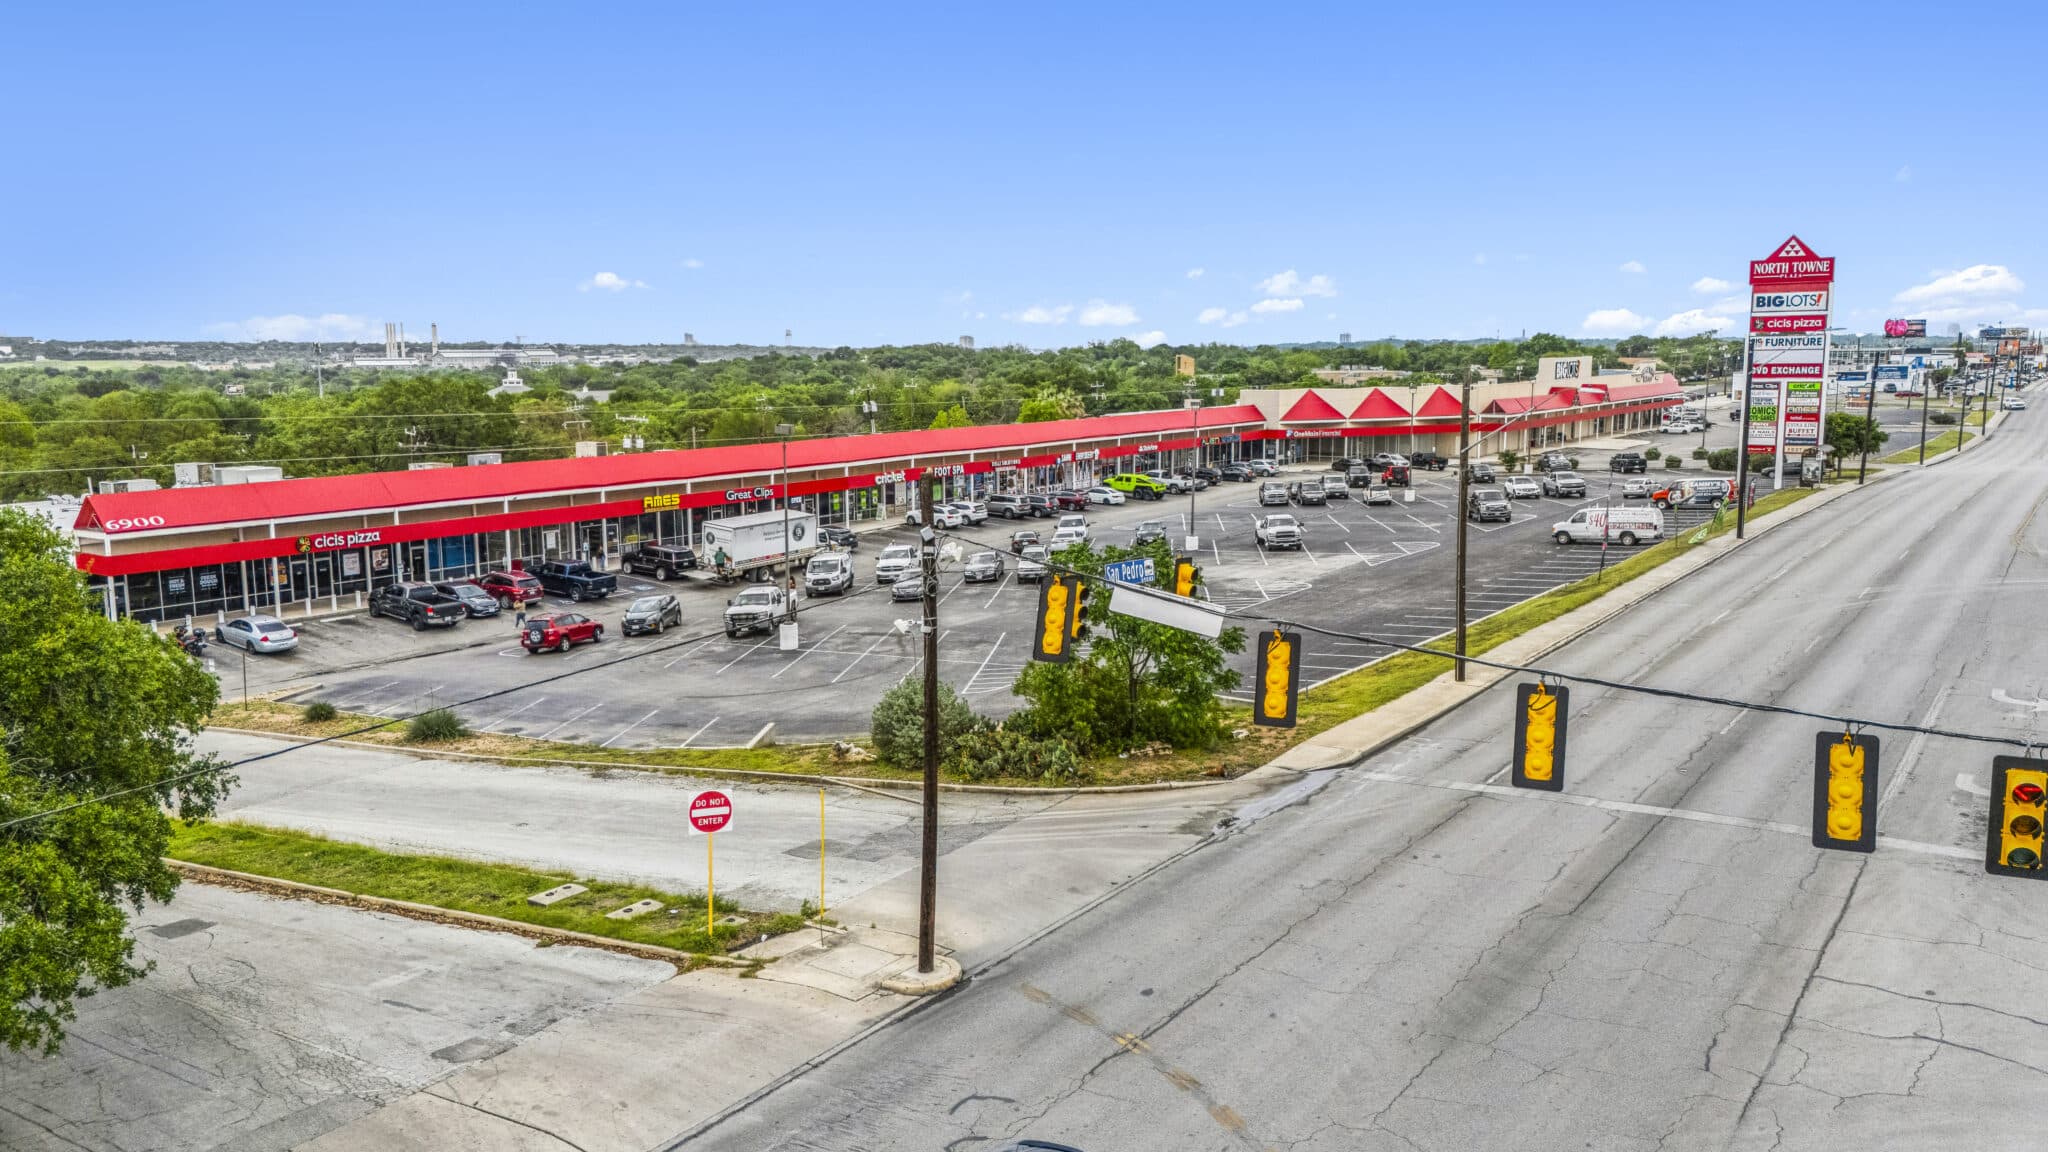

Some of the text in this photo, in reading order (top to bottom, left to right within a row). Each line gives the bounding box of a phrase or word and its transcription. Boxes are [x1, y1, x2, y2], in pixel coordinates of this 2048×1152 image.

[1754, 261, 1830, 274] NORTH TOWNE
[1756, 295, 1784, 307] BIG
[1767, 318, 1822, 329] cicis pizza
[1765, 337, 1822, 346] FURNITURE
[1771, 366, 1820, 374] EXCHANGE
[1751, 407, 1776, 415] OMICS
[934, 464, 964, 477] FOOT SPA
[875, 470, 906, 485] cricket
[726, 487, 774, 501] Great Clips
[643, 494, 680, 508] AMES
[105, 515, 166, 531] 6900
[314, 530, 380, 549] cicis pizza
[1106, 561, 1144, 582] San Pedro
[695, 798, 725, 807] DO NOT
[698, 817, 723, 825] ENTER
